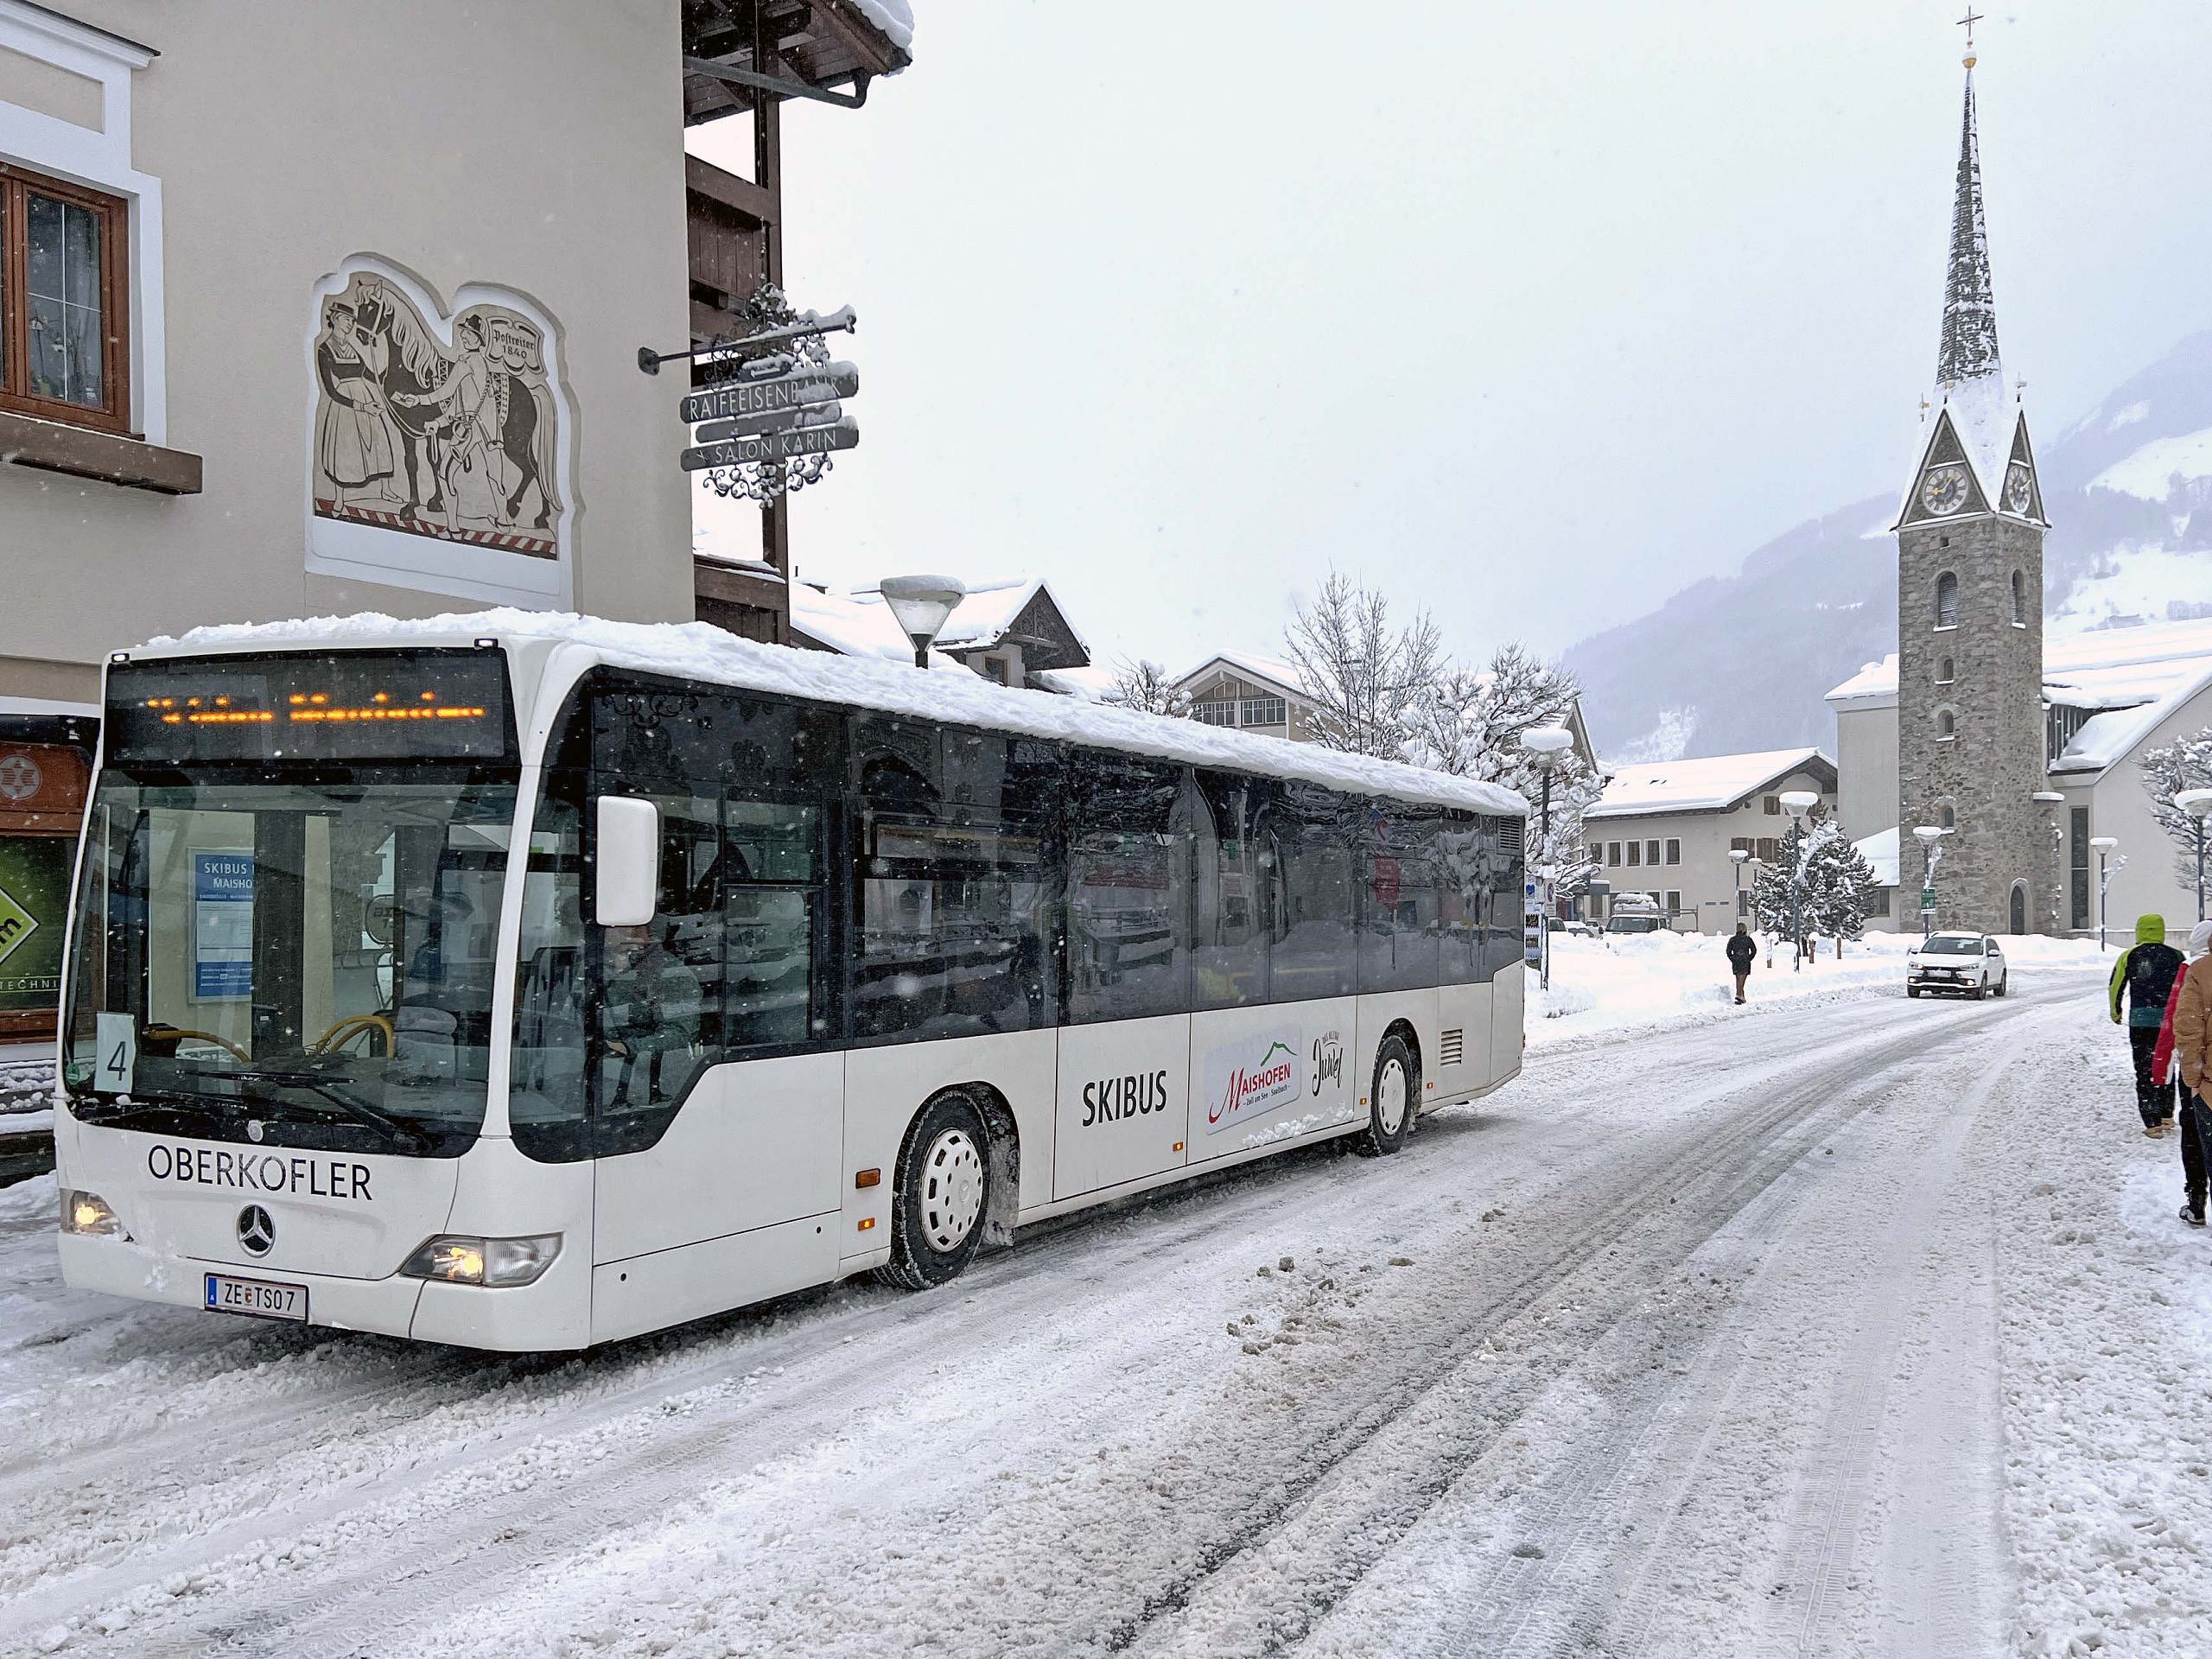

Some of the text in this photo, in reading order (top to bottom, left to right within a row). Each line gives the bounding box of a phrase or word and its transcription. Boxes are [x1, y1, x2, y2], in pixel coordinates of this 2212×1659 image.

[503, 346, 527, 359] 1840
[715, 430, 836, 464] SALON KARIN
[204, 862, 247, 874] SKIBUS
[107, 1041, 127, 1081] 4
[1082, 1070, 1167, 1128] SKIBUS
[1209, 1063, 1292, 1124] MAISHOFEN
[148, 1144, 373, 1201] OBERKOFLER
[225, 1283, 242, 1305] ZE
